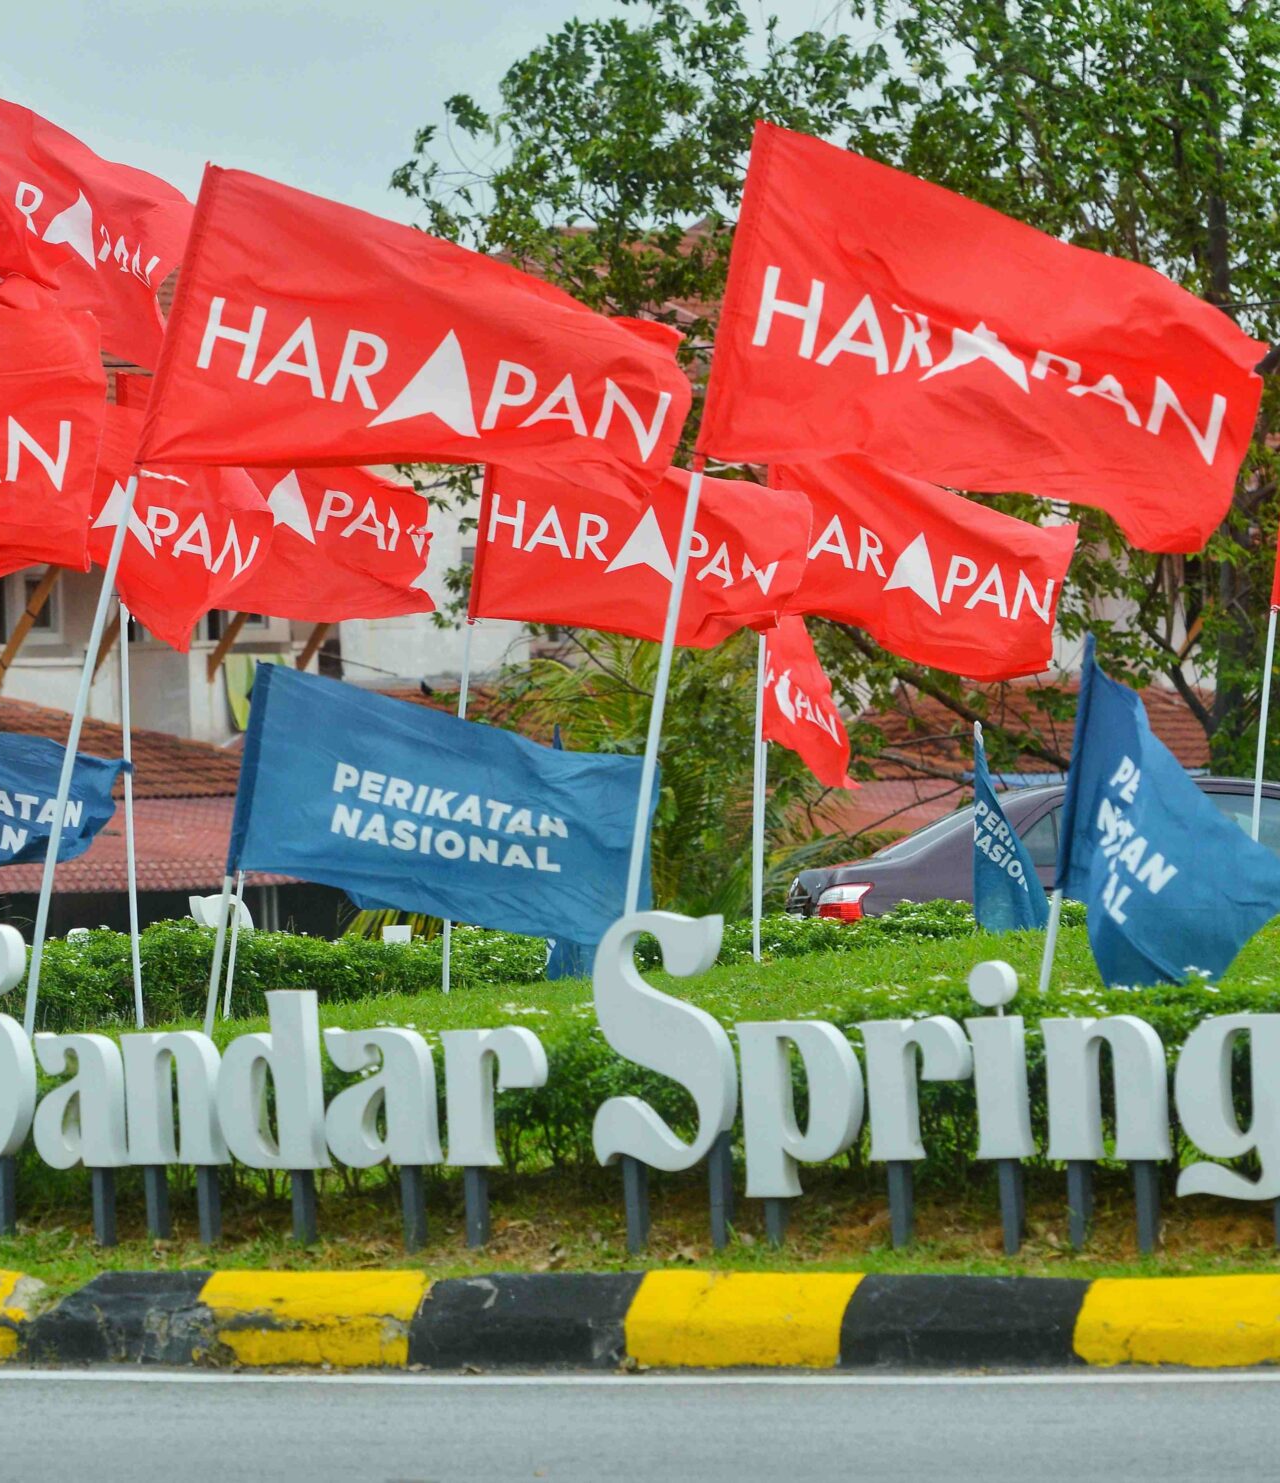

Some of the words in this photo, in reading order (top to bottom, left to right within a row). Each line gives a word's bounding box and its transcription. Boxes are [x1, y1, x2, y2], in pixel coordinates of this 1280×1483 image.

[197, 297, 671, 462] HARAPAN
[808, 514, 1054, 625] ARAPAN
[330, 804, 561, 873] NASIONAL
[333, 762, 569, 839] PERIKATAN
[593, 909, 1280, 1201] Spring
